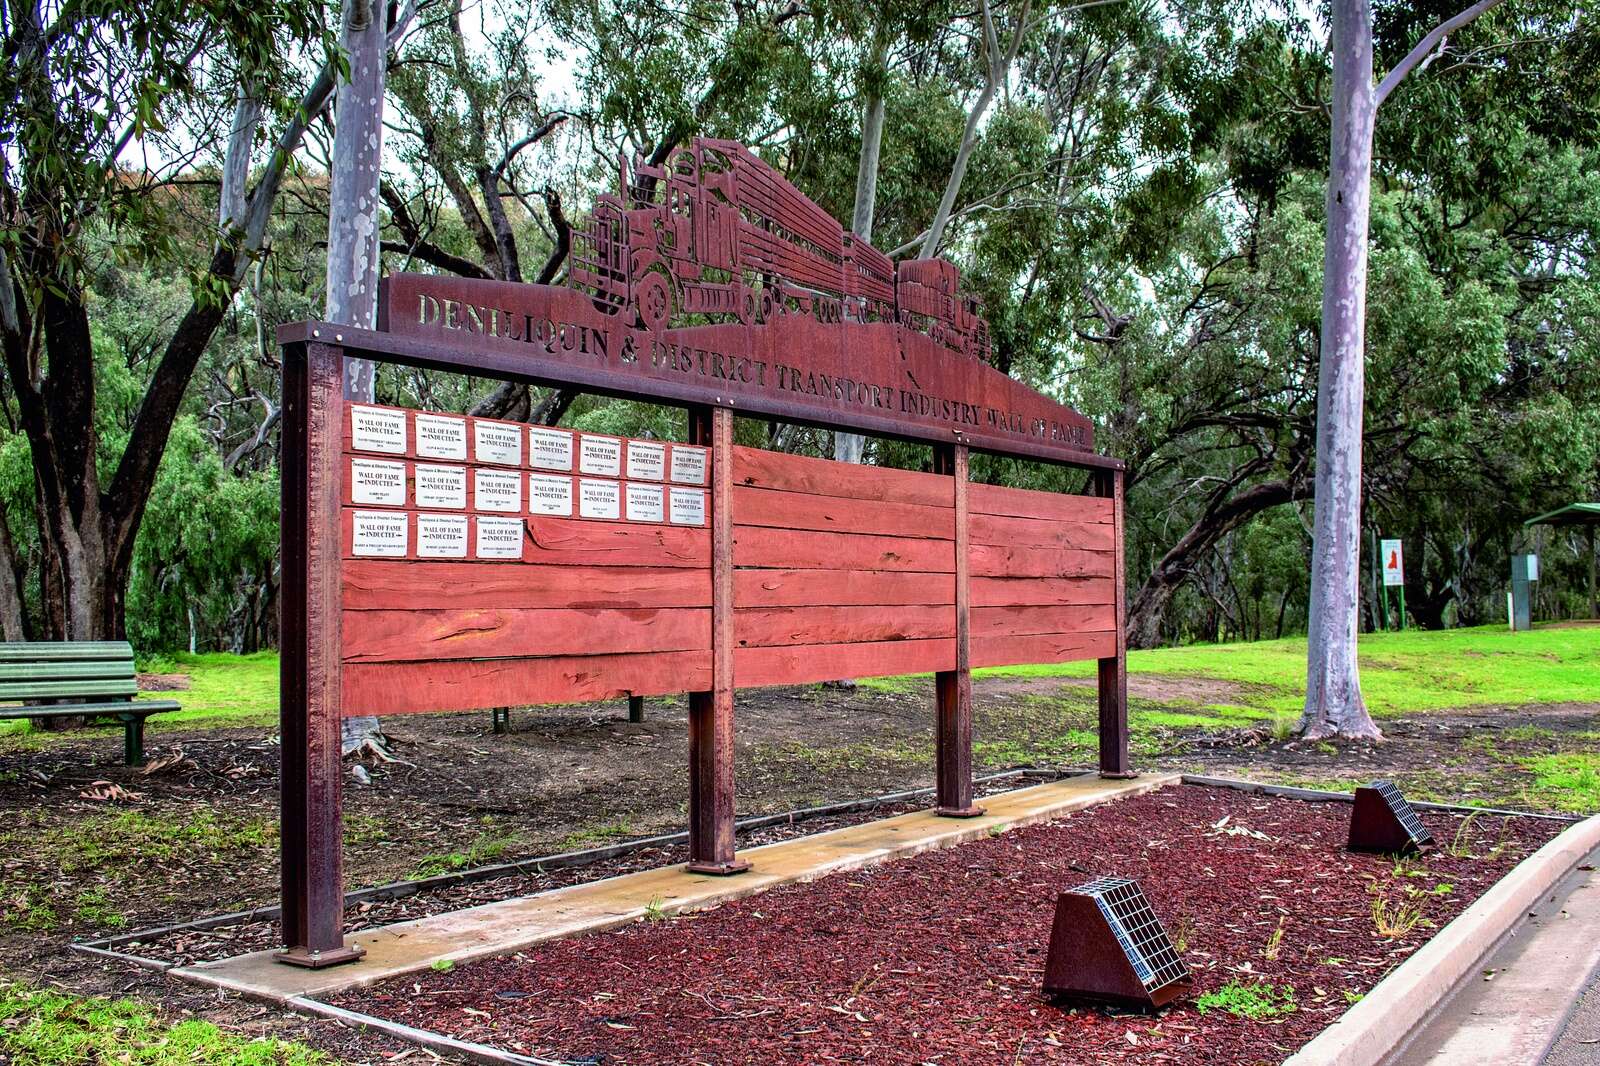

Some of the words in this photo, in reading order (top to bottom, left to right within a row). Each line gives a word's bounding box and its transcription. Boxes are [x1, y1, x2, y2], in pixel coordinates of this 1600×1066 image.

[418, 294, 608, 359] DENILIQUIN
[621, 335, 640, 362] &
[650, 340, 766, 386] DISTRICT
[775, 364, 893, 409] TRANSPORT
[900, 390, 980, 426] INDUSTRY
[986, 408, 1025, 434] WALL
[1030, 417, 1047, 437] OF
[1051, 421, 1086, 445] FAME
